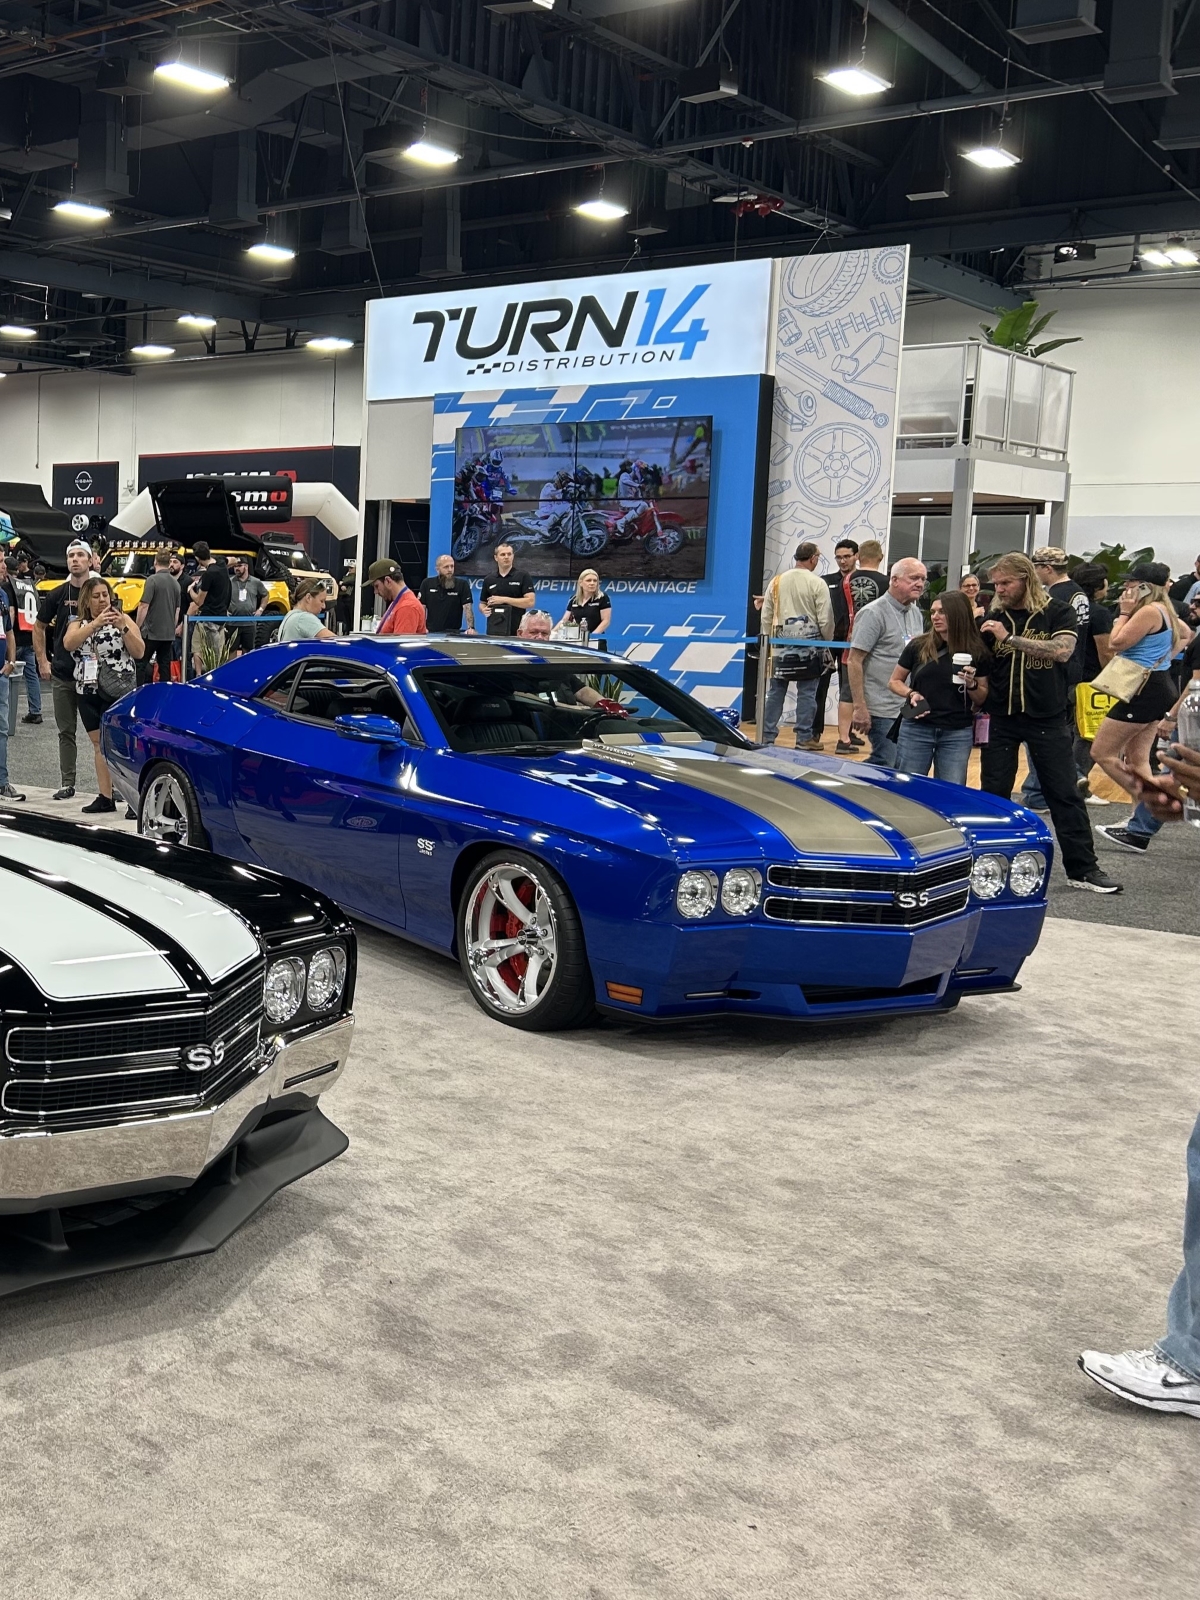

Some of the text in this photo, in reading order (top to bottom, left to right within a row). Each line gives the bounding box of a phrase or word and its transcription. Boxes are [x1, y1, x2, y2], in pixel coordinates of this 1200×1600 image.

[502, 348, 676, 373] DISTRIBUTION
[605, 580, 698, 593] ADVANTAGE
[416, 837, 435, 851] SS
[898, 889, 929, 908] SS
[185, 1041, 225, 1072] SS
